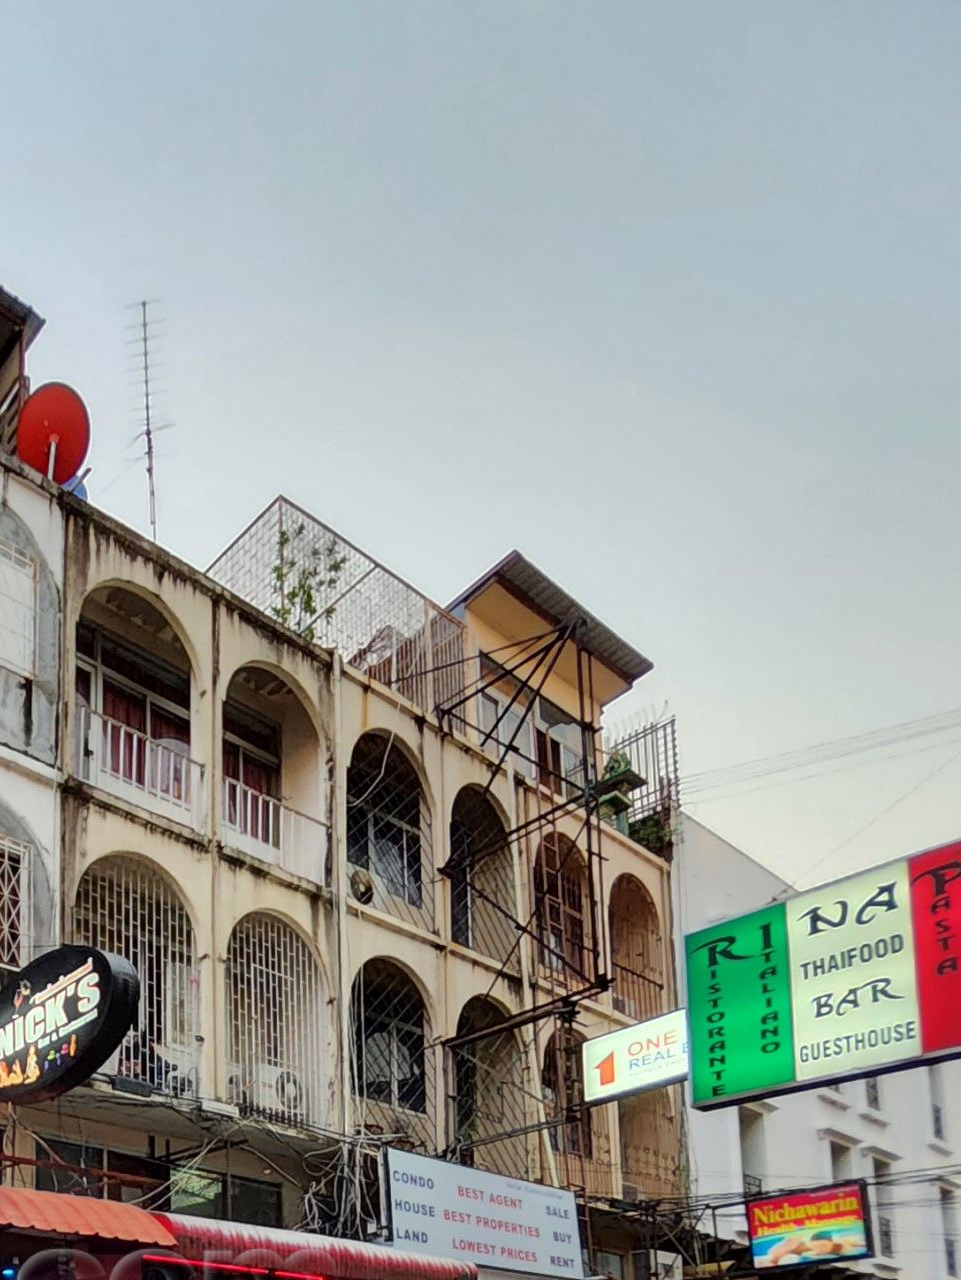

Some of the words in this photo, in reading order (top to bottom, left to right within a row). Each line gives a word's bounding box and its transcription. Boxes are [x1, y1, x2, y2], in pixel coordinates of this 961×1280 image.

[910, 861, 961, 976] PASTA
[800, 934, 904, 980] THAIFOOD
[758, 923, 781, 1054] ITALIANO
[811, 978, 905, 1018] BAR
[689, 936, 759, 1097] RISTORANTE
[627, 1029, 678, 1056] ONE
[800, 1021, 917, 1063] GUESTHOUSE
[629, 1048, 677, 1070] REAL
[393, 1170, 435, 1190] CONDO
[395, 1199, 435, 1218] HOUSE
[457, 1186, 484, 1201] BEST
[489, 1193, 523, 1209] AGENT
[443, 1209, 471, 1223] BEST
[476, 1216, 540, 1238] PROPERTIES
[545, 1205, 569, 1220] SALE
[396, 1227, 428, 1244] LAND
[553, 1231, 572, 1245] BUY
[452, 1238, 496, 1255] LOWEST
[500, 1246, 537, 1263] PRICES
[550, 1255, 574, 1269] RENT
